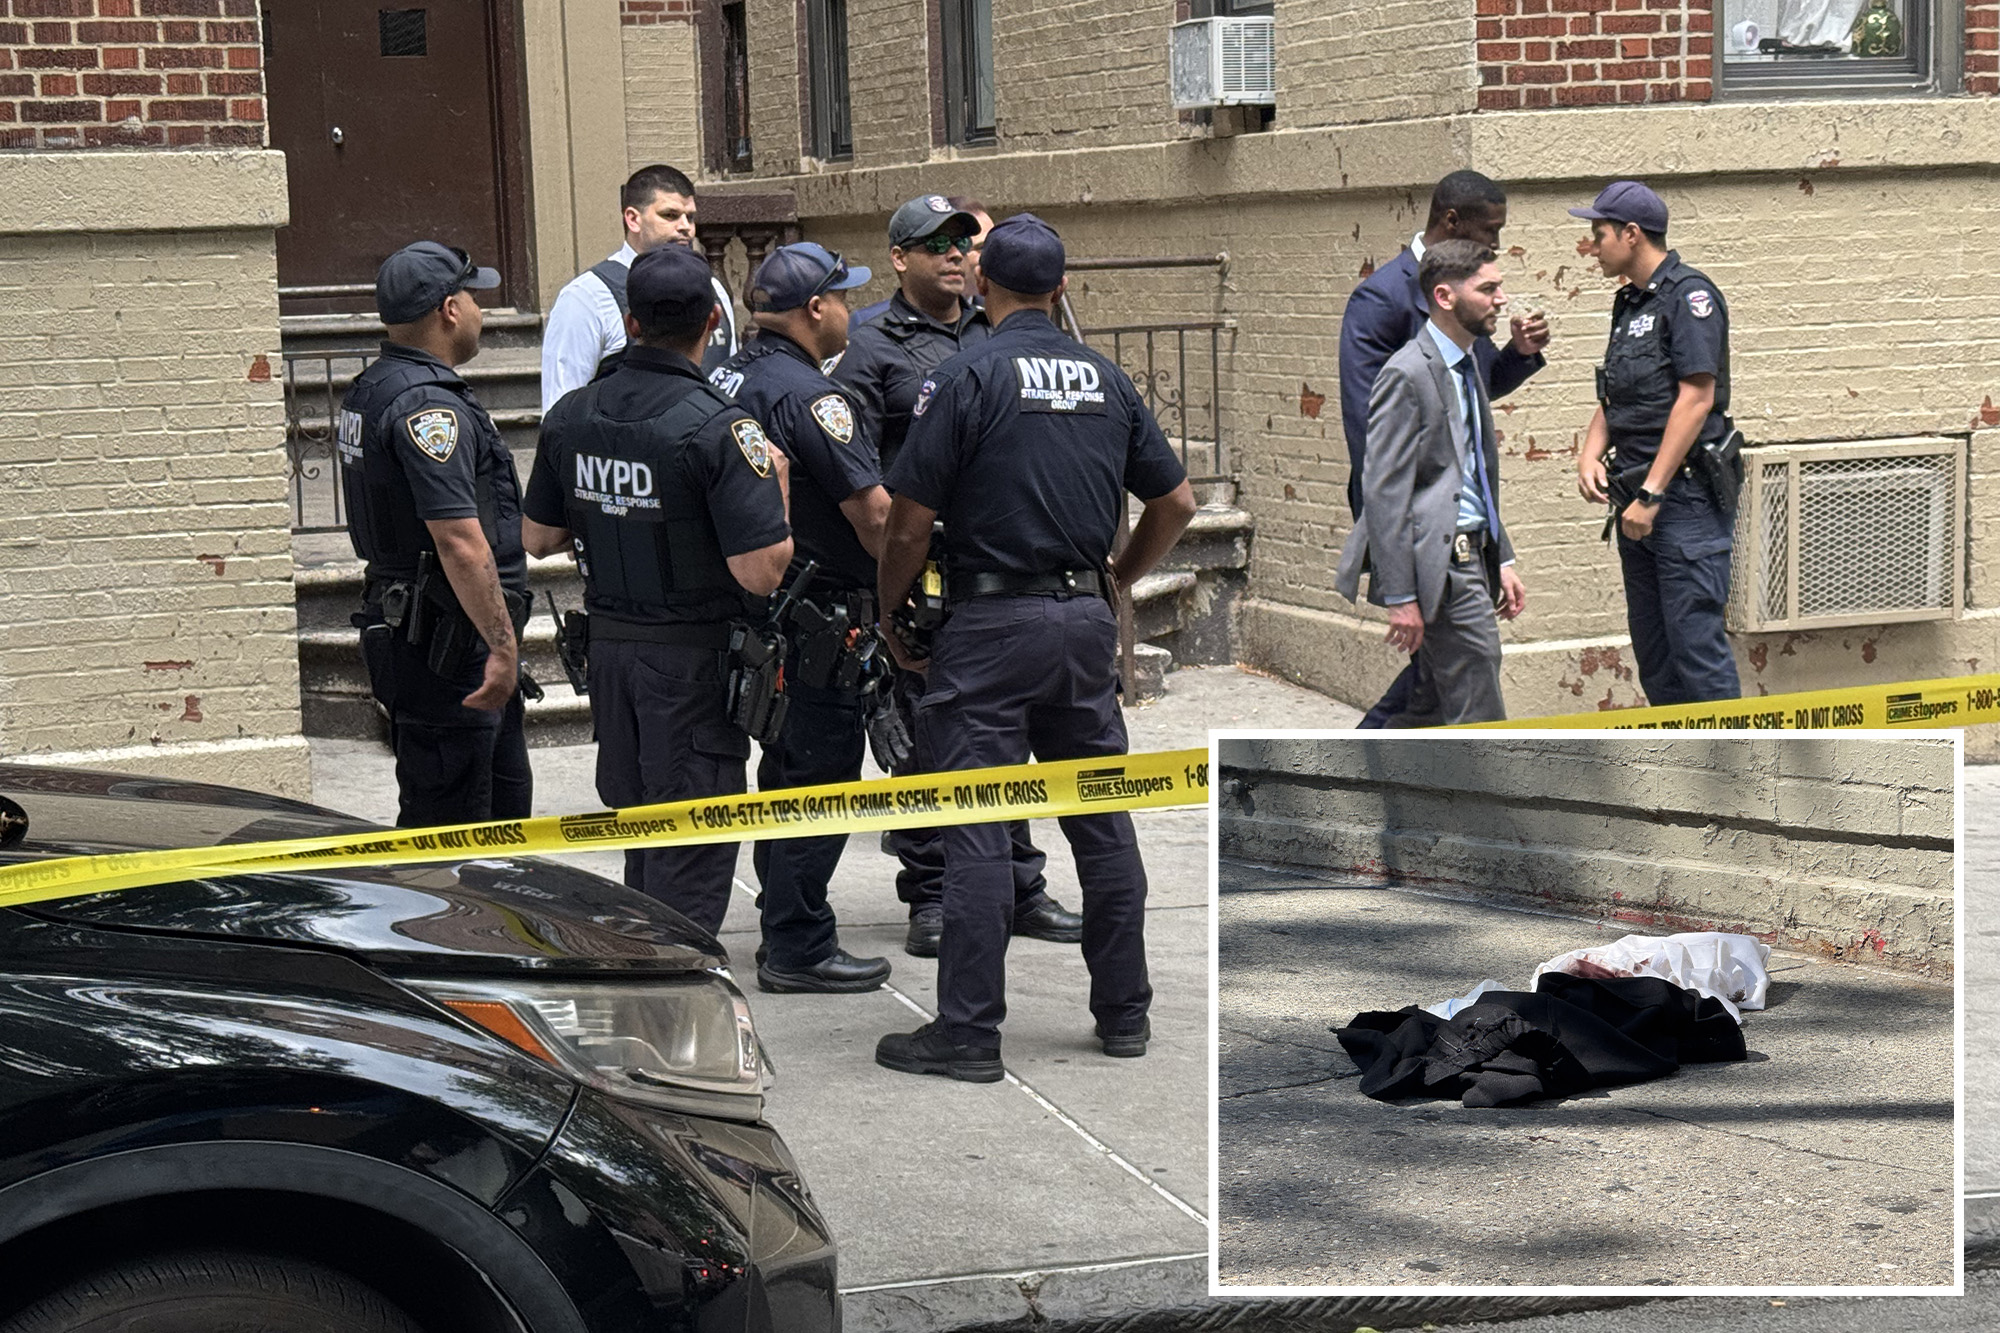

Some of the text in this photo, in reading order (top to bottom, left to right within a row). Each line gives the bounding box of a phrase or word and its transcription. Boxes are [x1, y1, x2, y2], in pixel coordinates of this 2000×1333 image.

[1017, 357, 1100, 391] NYPD
[1021, 388, 1105, 403] STRATEGIC RESPONSE
[1051, 400, 1077, 411] GROUP
[576, 453, 653, 497] NYPD
[574, 488, 662, 508] STRATEGIC RESPONSE
[601, 503, 629, 517] GROUP
[1753, 710, 1784, 729] SCENE
[1795, 709, 1809, 729] DO
[1811, 706, 1831, 729] NOT
[1832, 703, 1864, 727] CROSS
[1888, 700, 1958, 719] CRIMEstoppers
[1080, 775, 1174, 798] CRIMEstoppers
[688, 798, 802, 830] 1-800-577-TIPS
[850, 791, 896, 818] CRIME
[896, 787, 942, 814] SCENE
[954, 784, 974, 809] DO
[976, 782, 1002, 808] NOT
[1004, 779, 1048, 805] CROSS
[472, 822, 527, 847] CROSS
[565, 818, 677, 839] CRIMEstoppers
